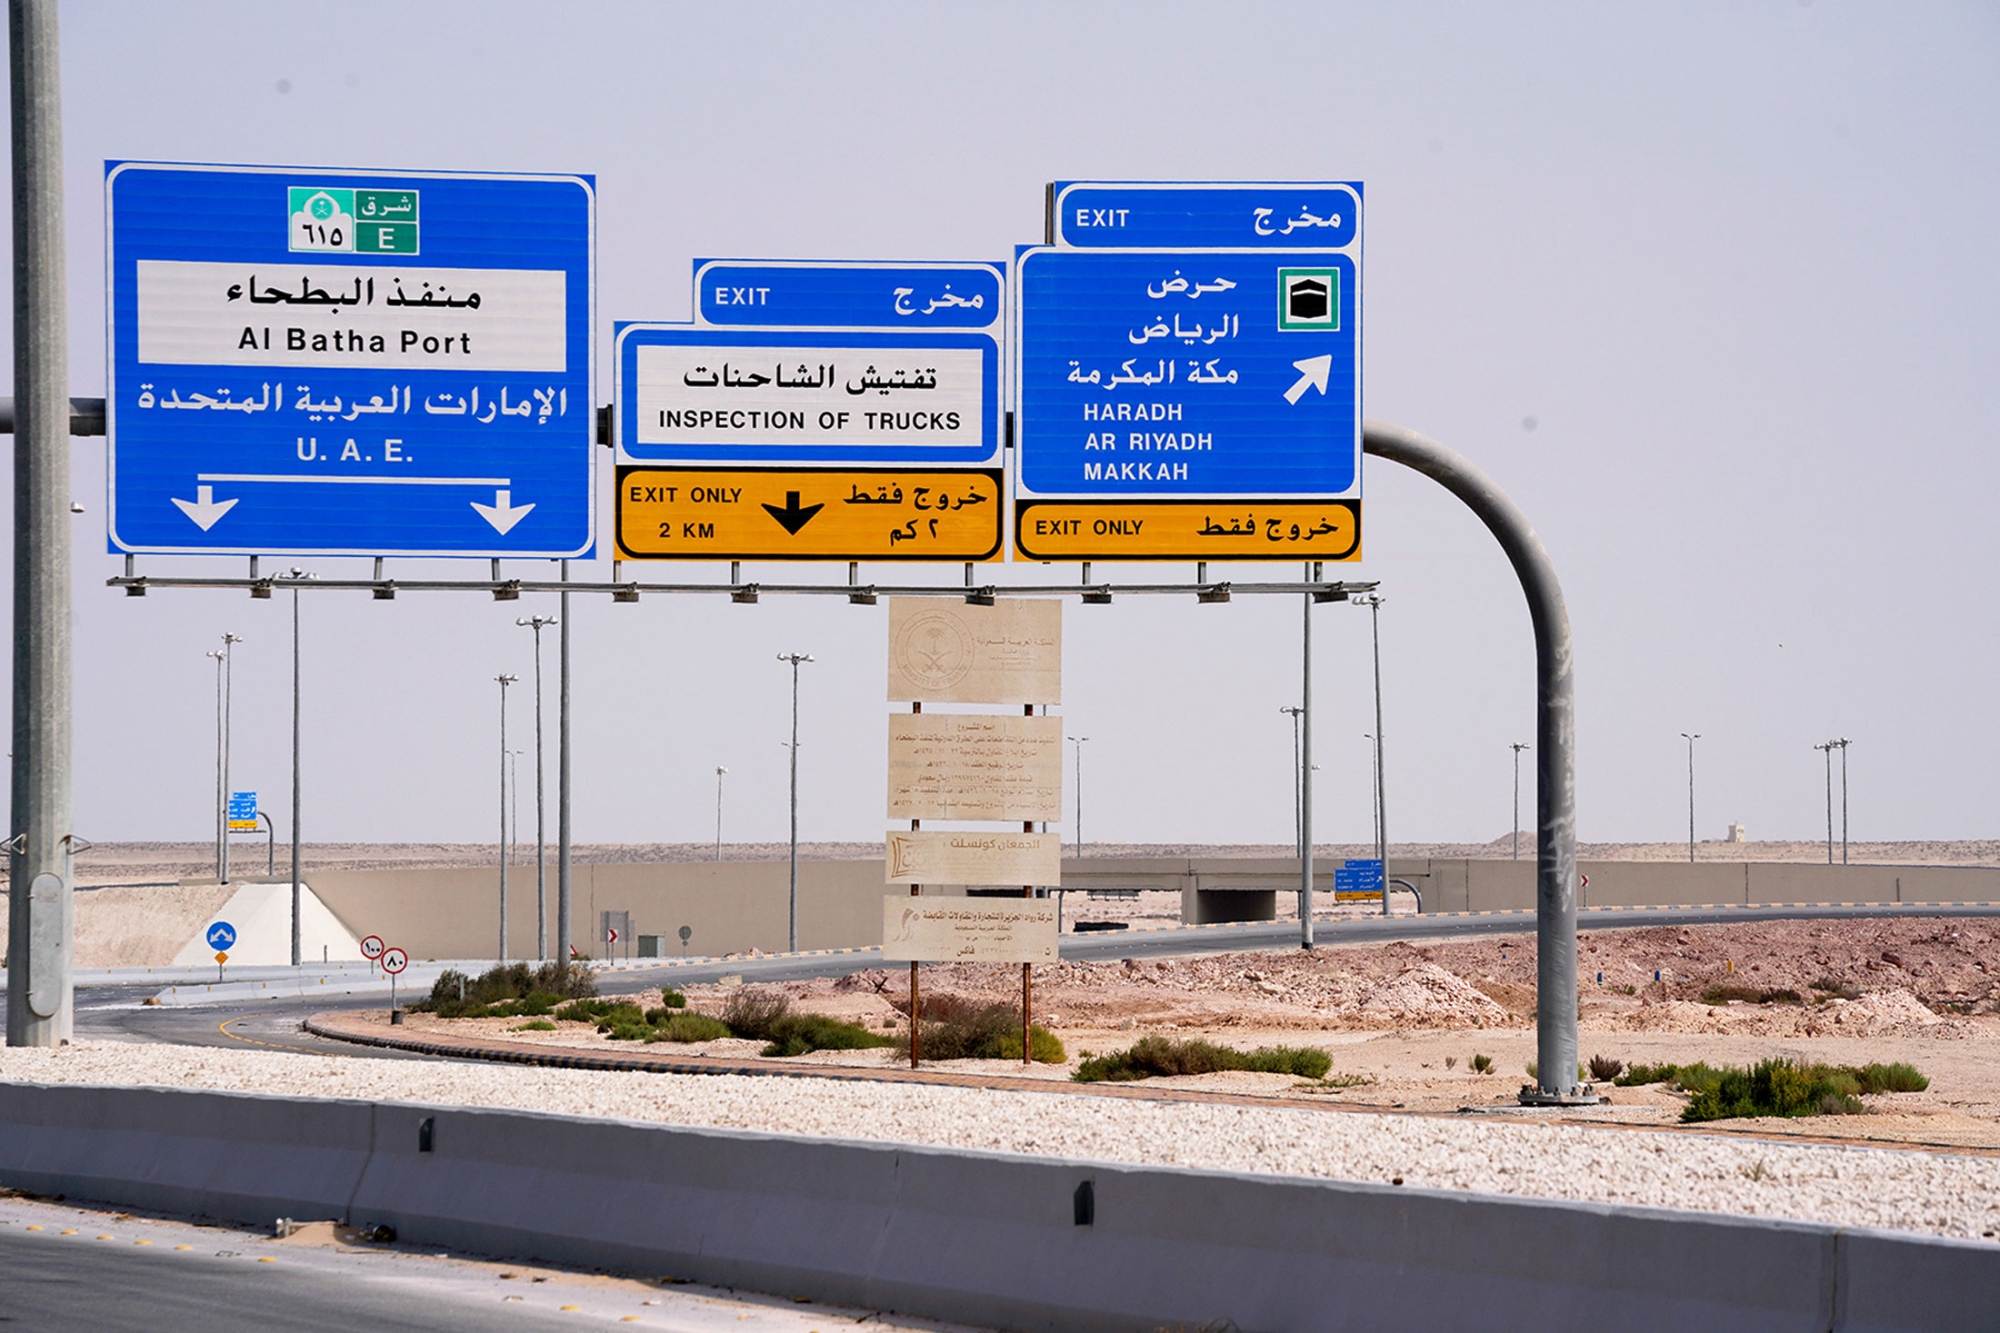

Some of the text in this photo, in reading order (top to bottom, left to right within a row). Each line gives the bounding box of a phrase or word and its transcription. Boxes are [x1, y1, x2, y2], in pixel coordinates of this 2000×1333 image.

[362, 197, 411, 216] شرق
[1077, 209, 1129, 226] EXIT
[1254, 206, 1341, 235] مخرج
[303, 225, 342, 246] ٦١٥
[379, 228, 394, 248] E
[1148, 271, 1236, 298] حرض
[227, 276, 480, 314] منفذ البطحاء
[716, 288, 770, 305] EXIT
[894, 285, 983, 315] مخرج
[1129, 314, 1238, 344] الرياض
[239, 327, 470, 354] Al Batha Port
[684, 363, 936, 395] تفتيش الشاحنات
[1068, 359, 1238, 389] مكة المكرمة
[139, 383, 566, 424] الإمارات العربية المتحدة
[1085, 404, 1181, 420] HARADH
[660, 410, 960, 429] INSPECTION OF TRUCKS
[298, 438, 412, 461] U. A. E.
[1085, 433, 1211, 450] AR RIYADH
[1085, 463, 1187, 480] MAKKAH
[631, 487, 741, 502] EXIT ONLY
[844, 483, 987, 510] خروج فقط
[660, 523, 713, 538] 2 KM
[891, 519, 938, 546] ٢ كم
[1036, 520, 1143, 535] EXIT ONLY
[1197, 514, 1338, 541] خروج فقط
[949, 838, 996, 852] كونسلت
[365, 942, 380, 953] ١٠٠
[387, 956, 403, 967] ٨٠
